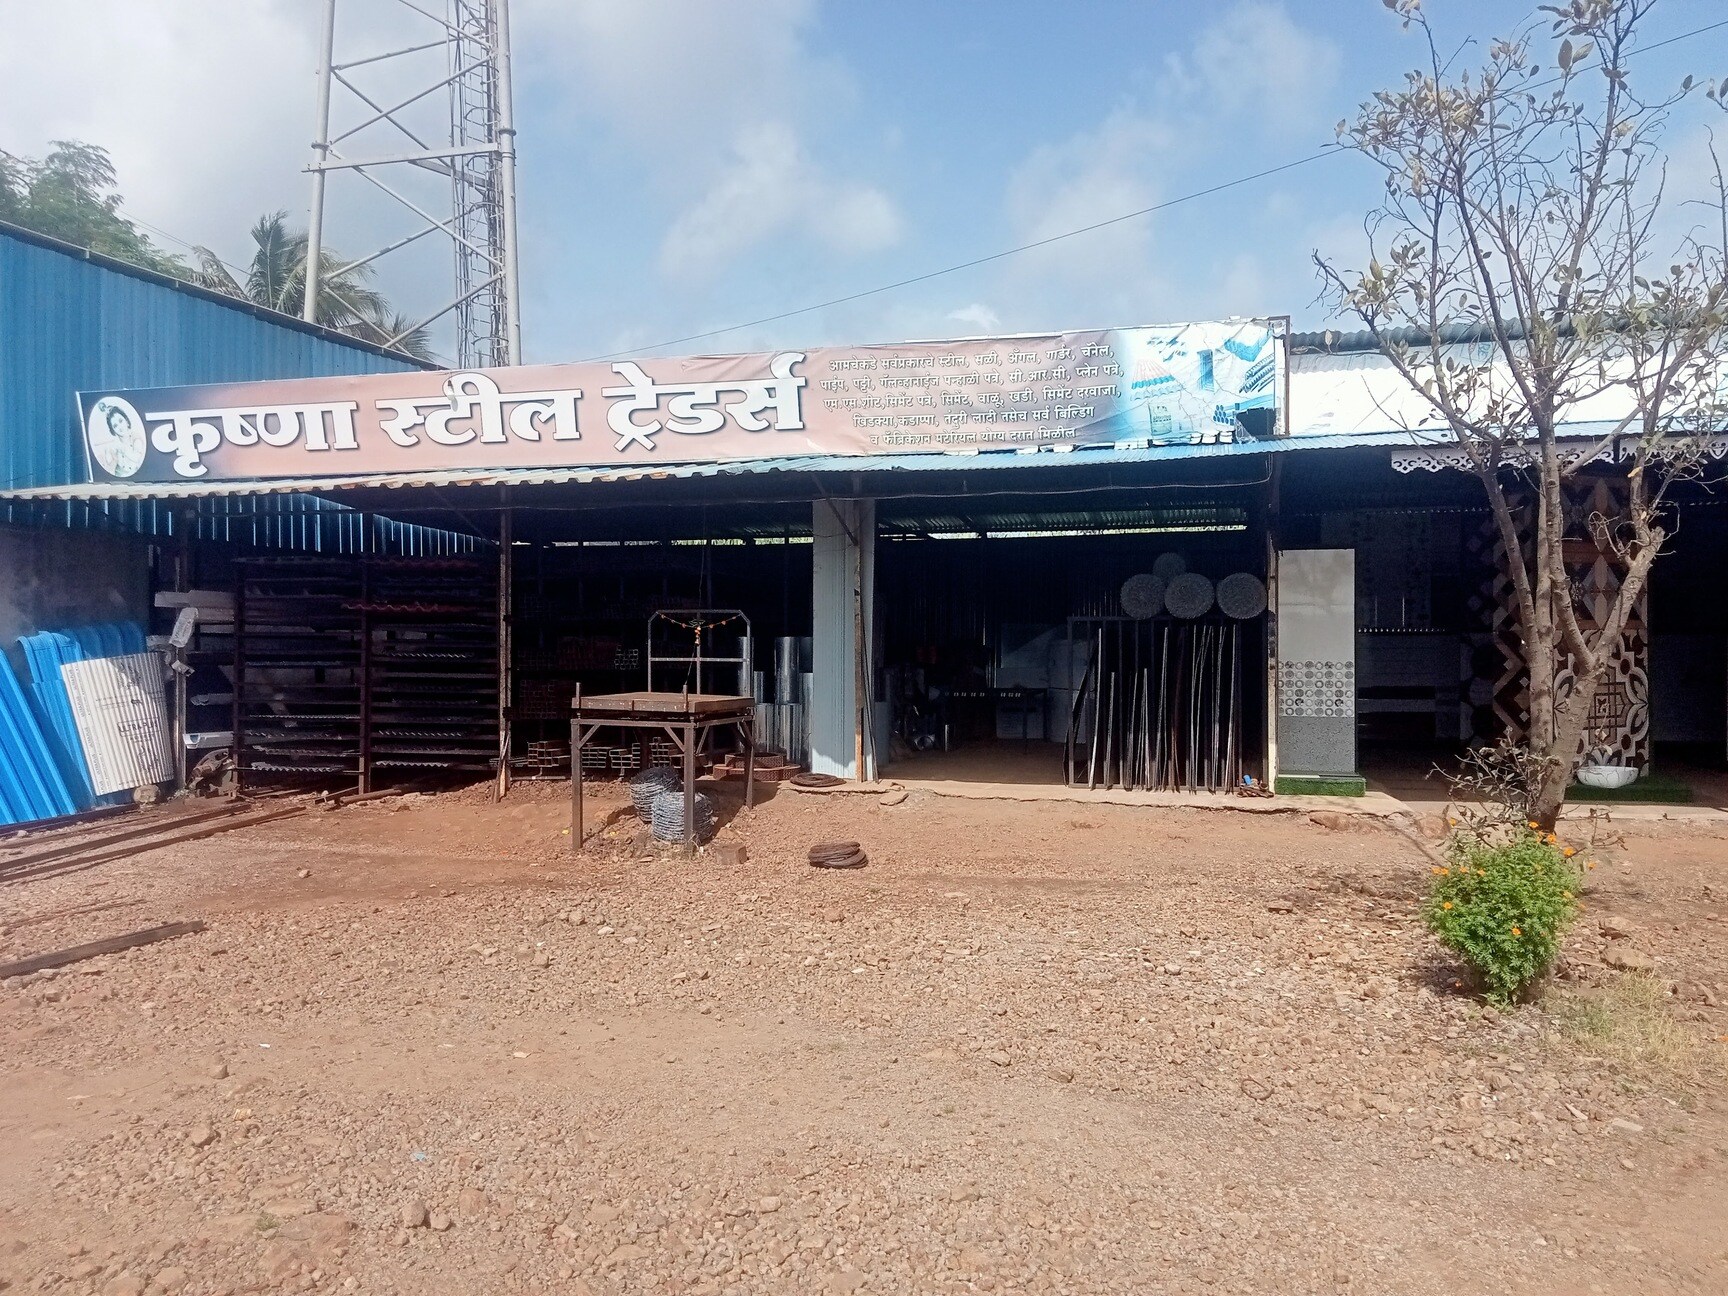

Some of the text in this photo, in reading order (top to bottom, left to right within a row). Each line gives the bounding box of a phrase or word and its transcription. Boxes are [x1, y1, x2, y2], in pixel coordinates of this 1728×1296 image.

[829, 355, 877, 371] आमचेकडे
[880, 353, 934, 369] सर्वप्रकारचे
[938, 352, 970, 367] स्टील,
[974, 351, 1002, 366] सळी,
[1045, 344, 1076, 361] गार्डर,
[820, 375, 849, 392] पाईप,
[852, 375, 876, 392] पट्टी,
[943, 370, 980, 386] पन्हाळी
[983, 368, 1004, 385] पत्रे,
[1075, 362, 1099, 378] प्लेन
[1102, 361, 1124, 377] पत्रे,
[917, 391, 937, 408] पत्रे,
[940, 390, 973, 407] सिमेंट,
[978, 392, 1004, 407] वाळू,
[1009, 387, 1038, 403] खडी,
[1042, 384, 1073, 400] सिमेंट
[1077, 384, 1121, 399] दरवाजा,
[145, 352, 806, 478] कृष्णा स्टील ट्रेडर्स
[943, 409, 968, 429] तंदुरी
[971, 409, 997, 424] लादी
[1001, 407, 1028, 421] तसेच
[1032, 405, 1050, 420] सर्व
[1054, 402, 1095, 419] बिल्डिंग
[870, 434, 879, 445] व
[883, 430, 932, 446] फॅब्रिकेशन
[935, 429, 978, 444] मटेरियल
[981, 427, 1005, 441] योग्य
[1010, 429, 1034, 443] दरात
